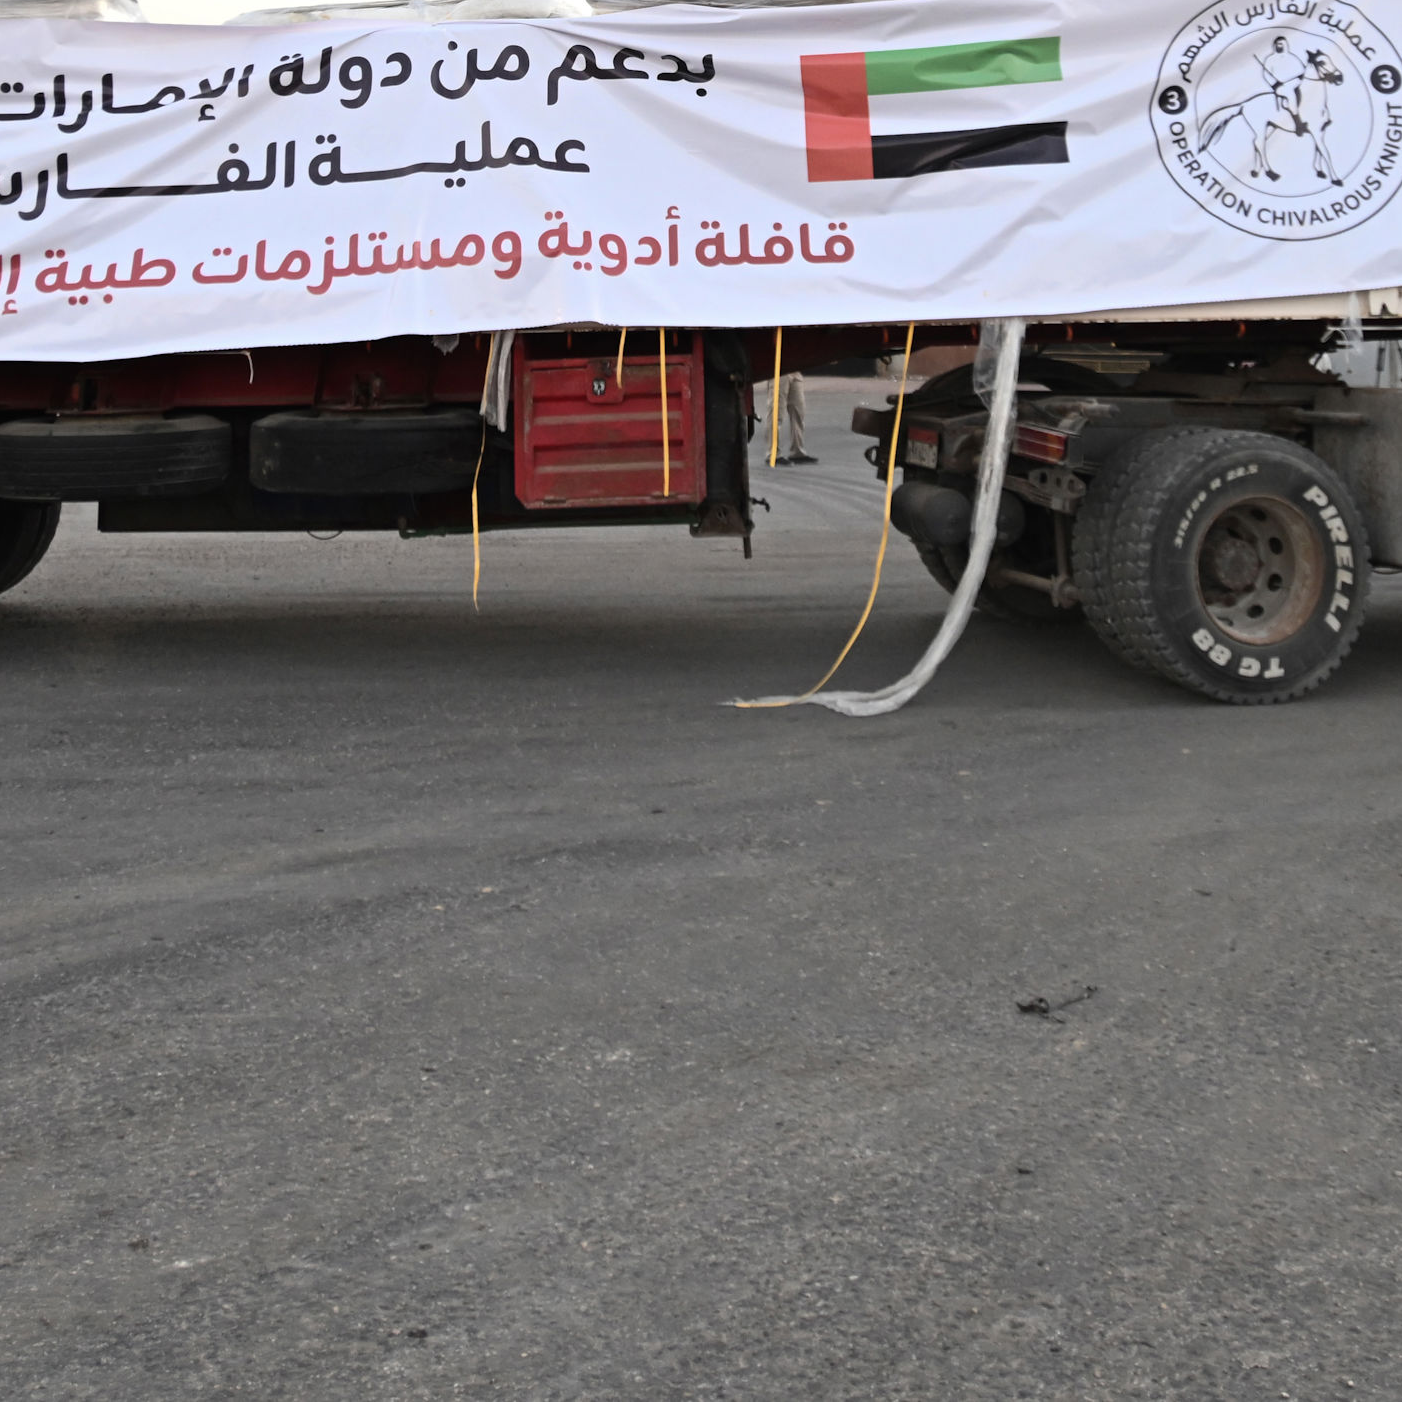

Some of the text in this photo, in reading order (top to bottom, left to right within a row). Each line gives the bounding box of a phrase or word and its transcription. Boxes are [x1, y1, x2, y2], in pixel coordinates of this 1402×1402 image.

[1177, 10, 1228, 84] الشهم
[1318, 6, 1378, 63] عملية
[277, 46, 410, 110] دولة
[428, 40, 530, 99] من
[546, 44, 717, 105] بدعم
[1379, 68, 1396, 91] 3
[1166, 90, 1181, 113] 3
[307, 121, 591, 190] عملية
[1169, 120, 1253, 217] OPERATION
[1256, 170, 1382, 227] CHIVALROUS
[191, 230, 523, 295] ومستلزمات
[537, 205, 680, 274] أدوية
[694, 219, 855, 267] قافلة
[34, 247, 177, 307] طبية
[1302, 484, 1355, 633] PIRELLI
[1190, 627, 1287, 680] TG 88
